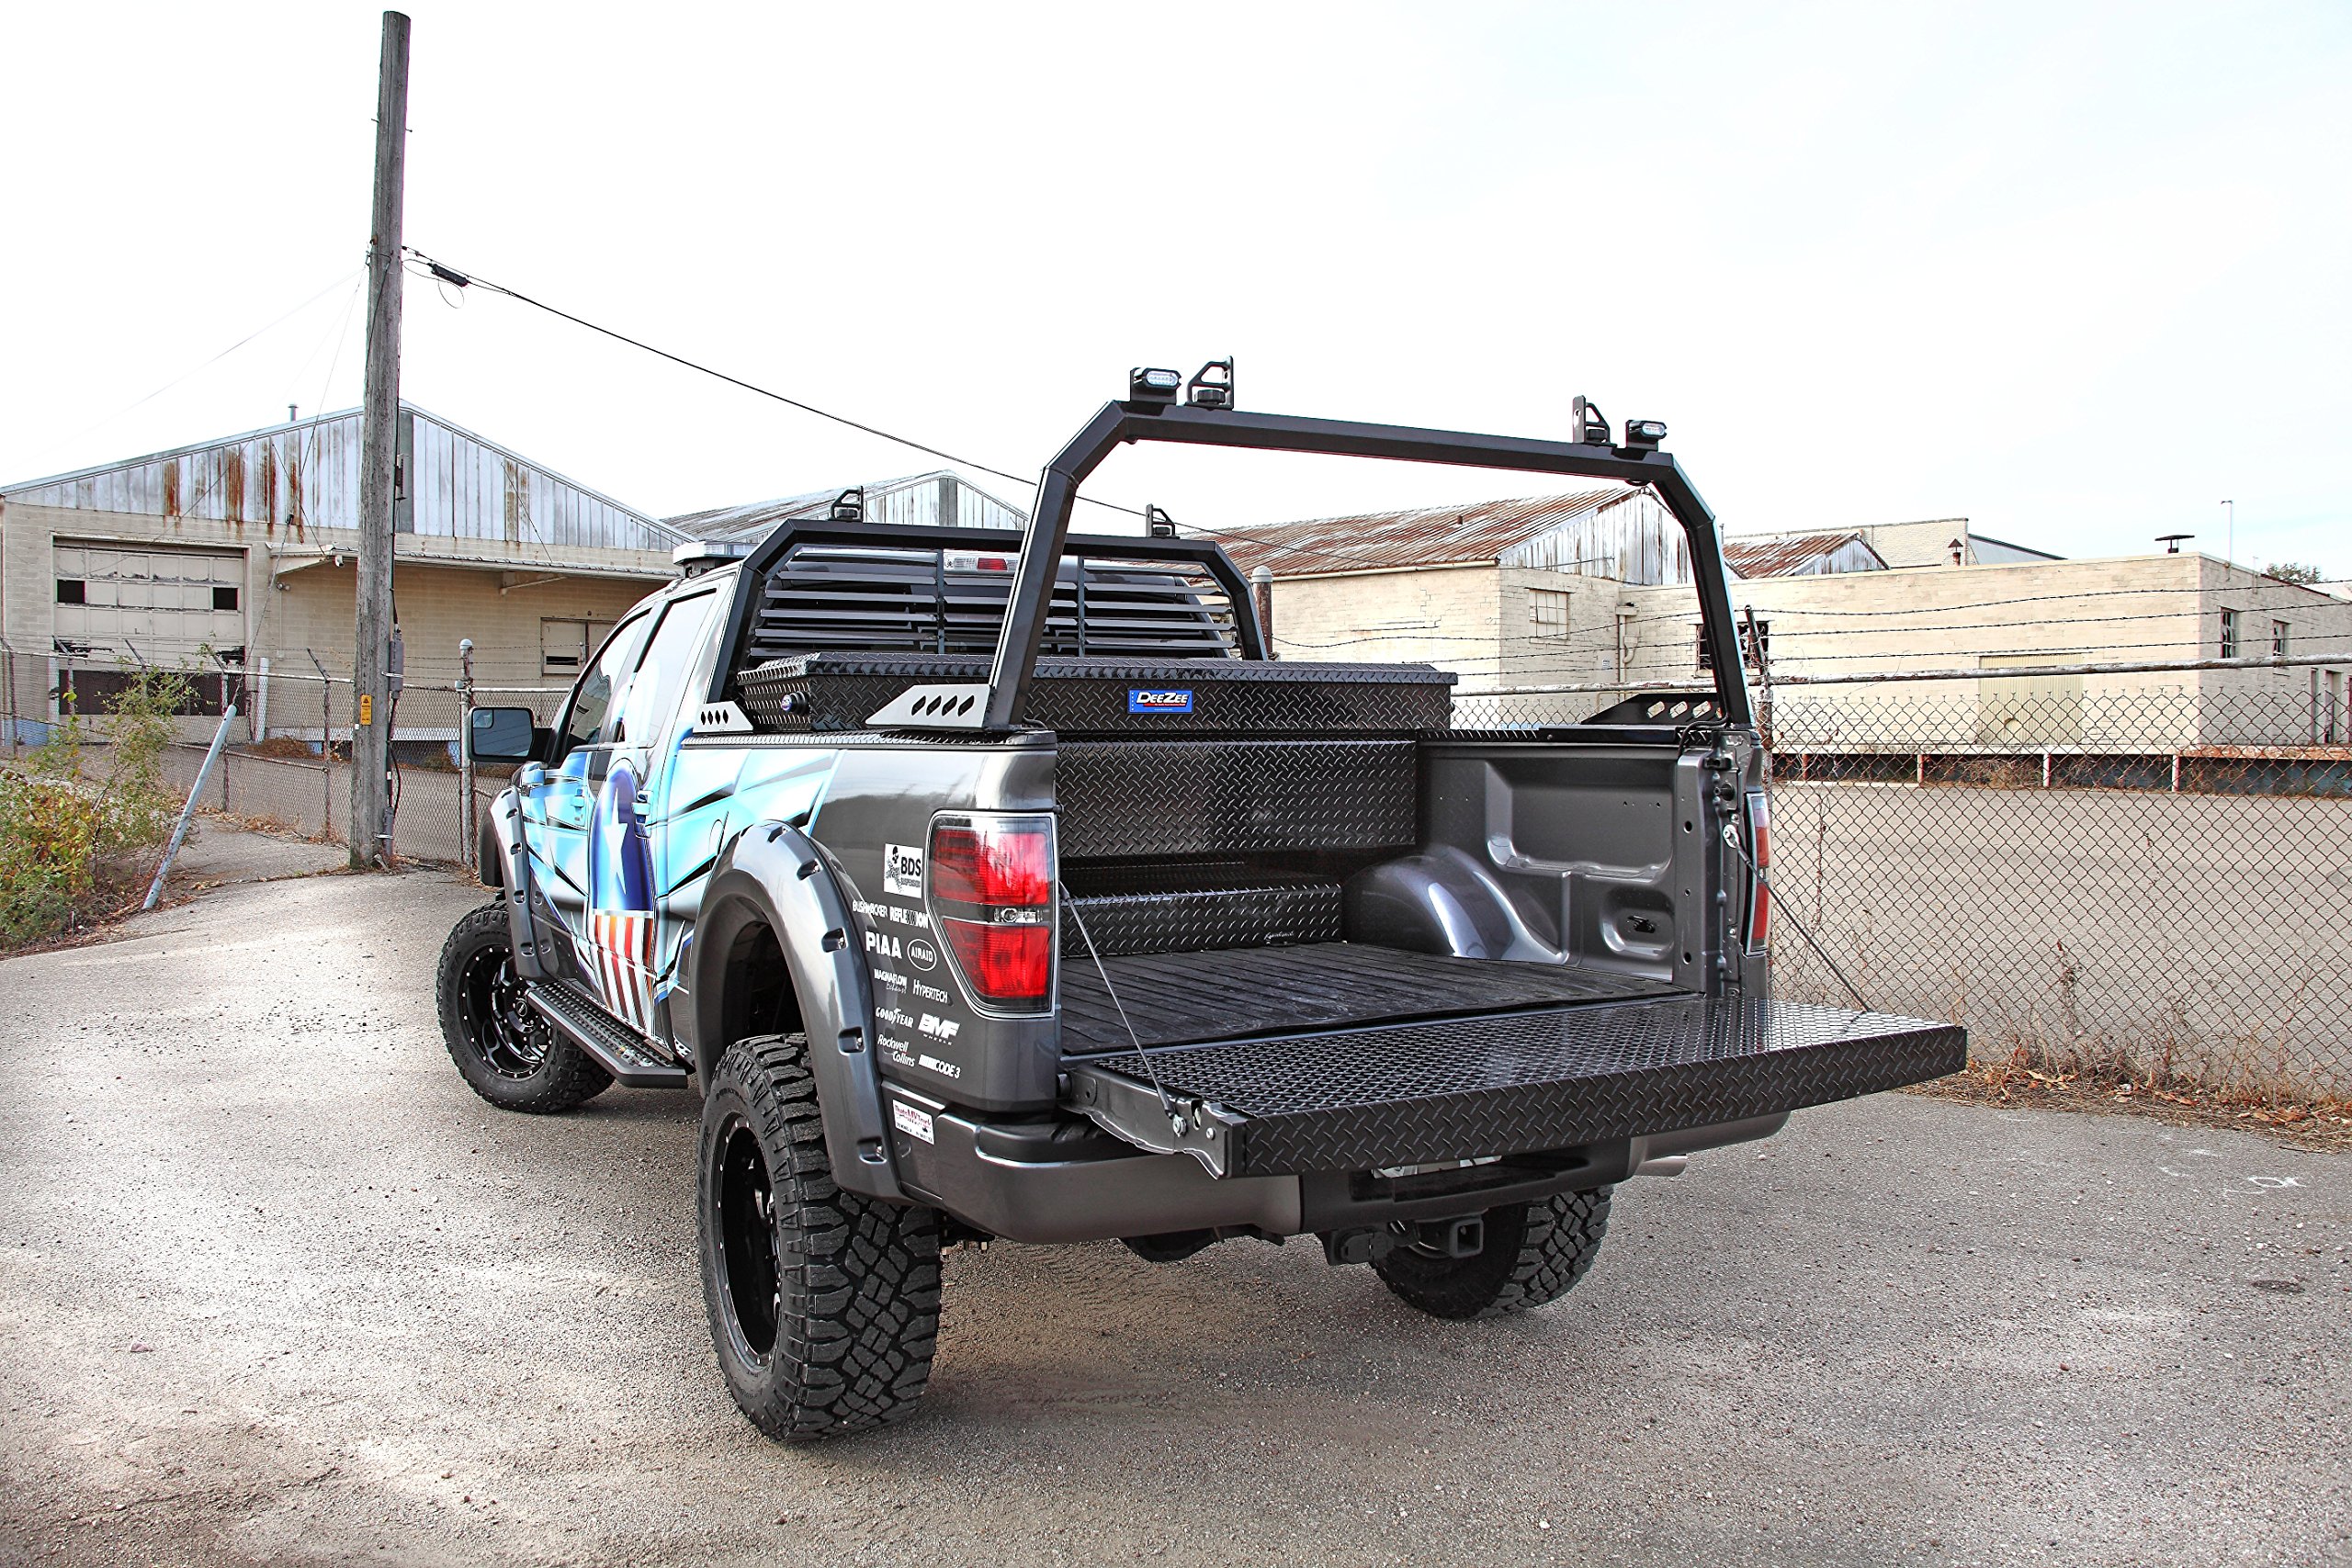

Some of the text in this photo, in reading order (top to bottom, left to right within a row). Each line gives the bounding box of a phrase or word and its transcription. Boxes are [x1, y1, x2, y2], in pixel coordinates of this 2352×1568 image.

[900, 856, 922, 876] BDS
[853, 899, 888, 918] BUSHWACKER
[865, 931, 902, 959] PIAA
[910, 946, 933, 963] AIRAID
[874, 968, 908, 987] MAGNAFLOW
[876, 1007, 914, 1028] GOODYEAR
[918, 1012, 960, 1039] BMF
[877, 1033, 910, 1053] Rockwell
[892, 1051, 916, 1067] Collins
[935, 1059, 961, 1079] CODE 3
